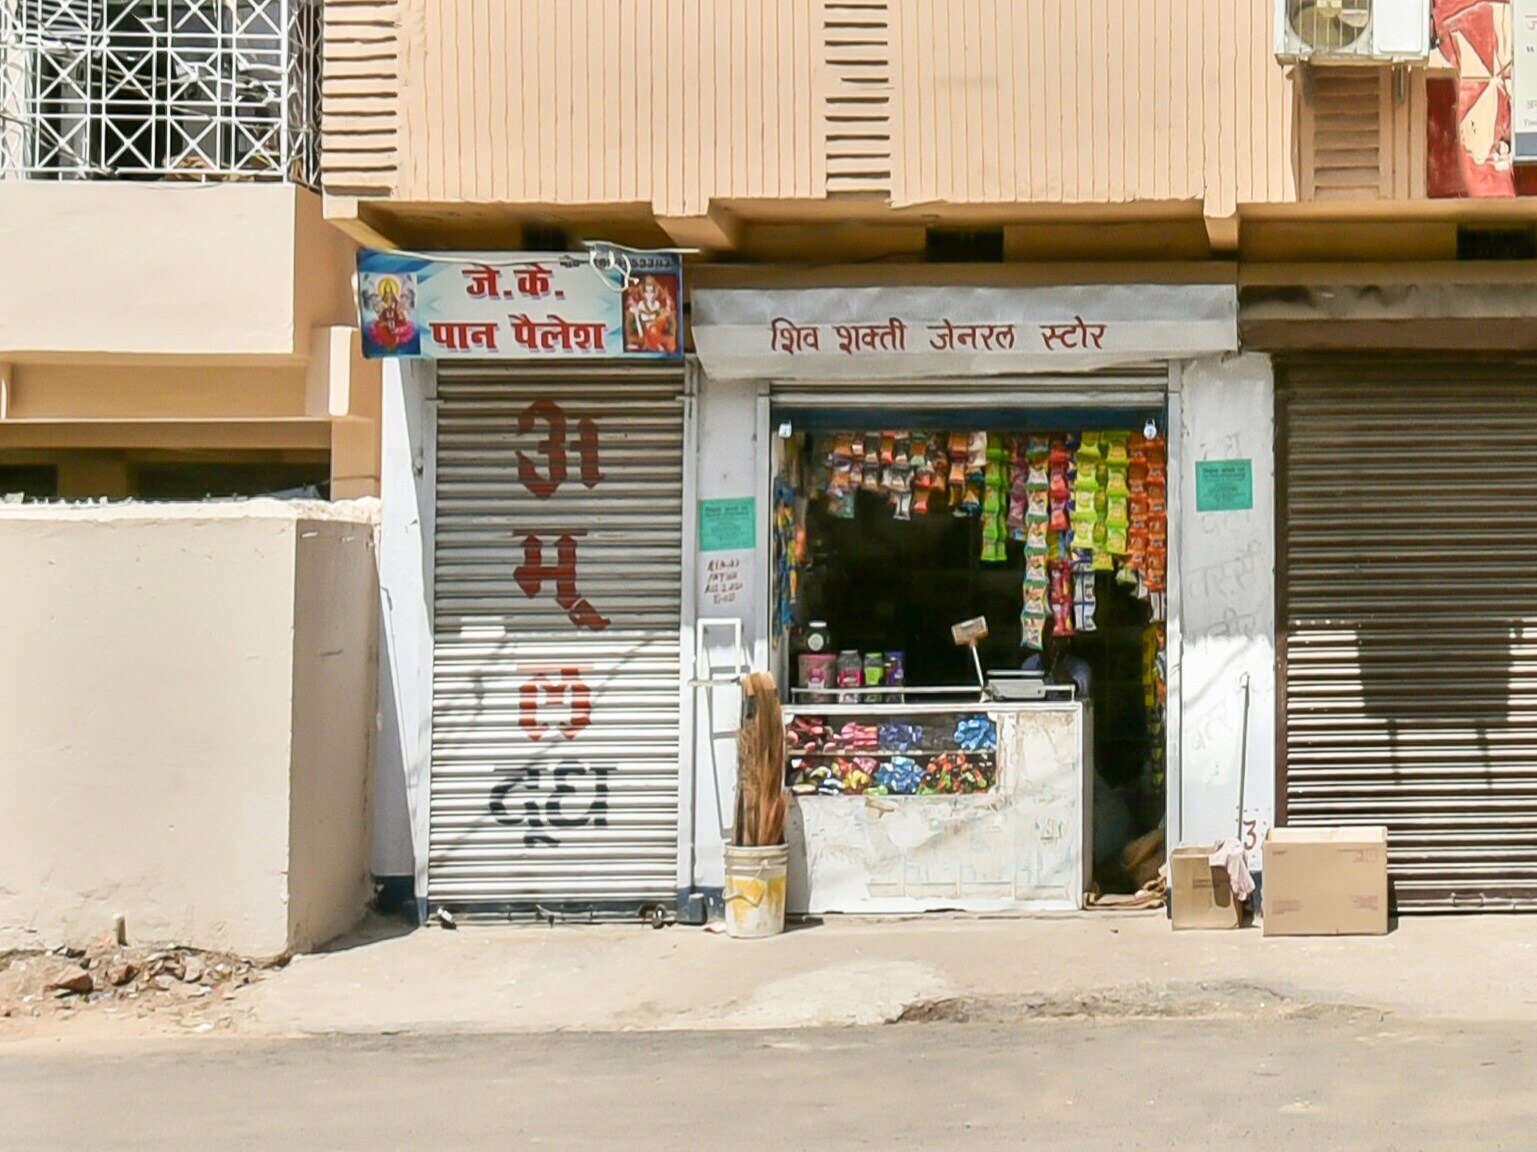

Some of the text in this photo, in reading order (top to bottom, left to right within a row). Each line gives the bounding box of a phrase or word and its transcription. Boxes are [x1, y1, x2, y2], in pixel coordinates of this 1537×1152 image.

[428, 313, 607, 353] पान पैलेश
[770, 315, 1108, 356] शिव शक्ती जेनरल स्टोर
